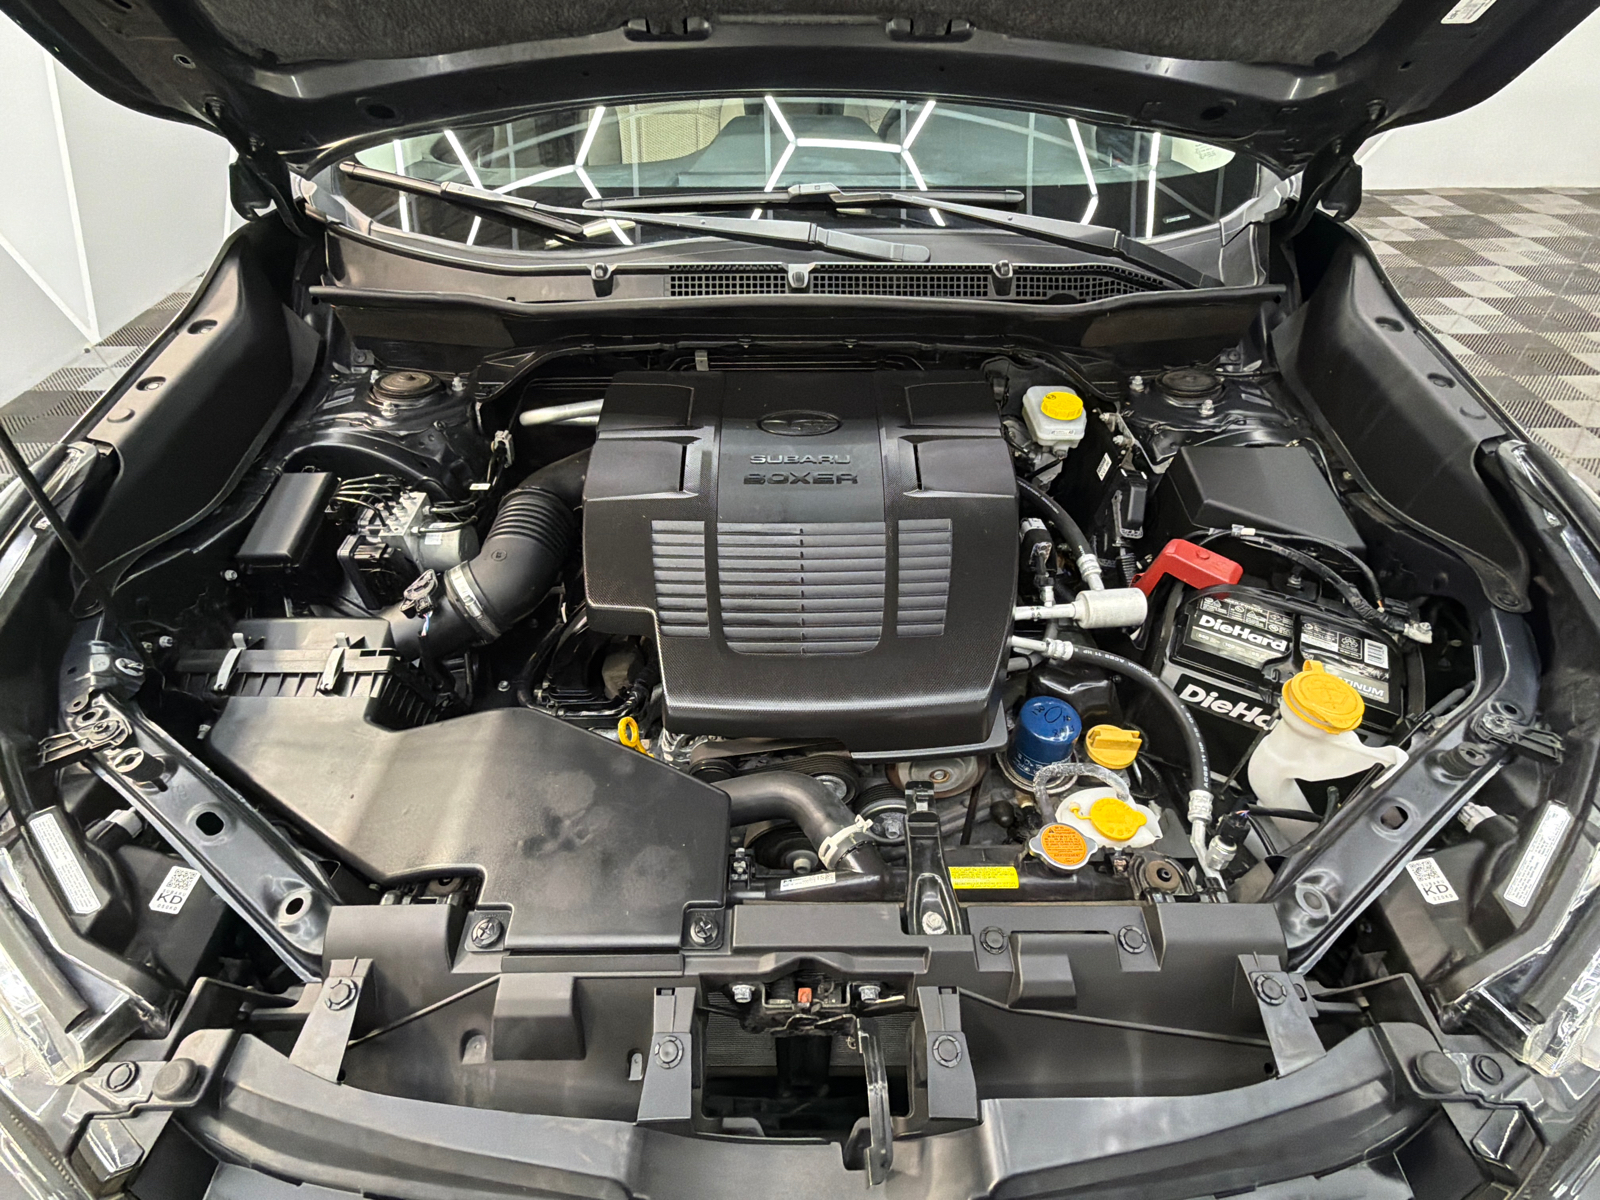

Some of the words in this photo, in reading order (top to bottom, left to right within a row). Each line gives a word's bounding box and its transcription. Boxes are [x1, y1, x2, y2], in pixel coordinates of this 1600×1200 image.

[750, 454, 851, 464] SUBARU
[743, 472, 859, 485] BOXER
[1199, 614, 1288, 652] DieHard
[1338, 676, 1385, 698] TINUM
[1179, 683, 1280, 731] DieHa
[1423, 884, 1449, 896] KD
[156, 892, 183, 905] KD
